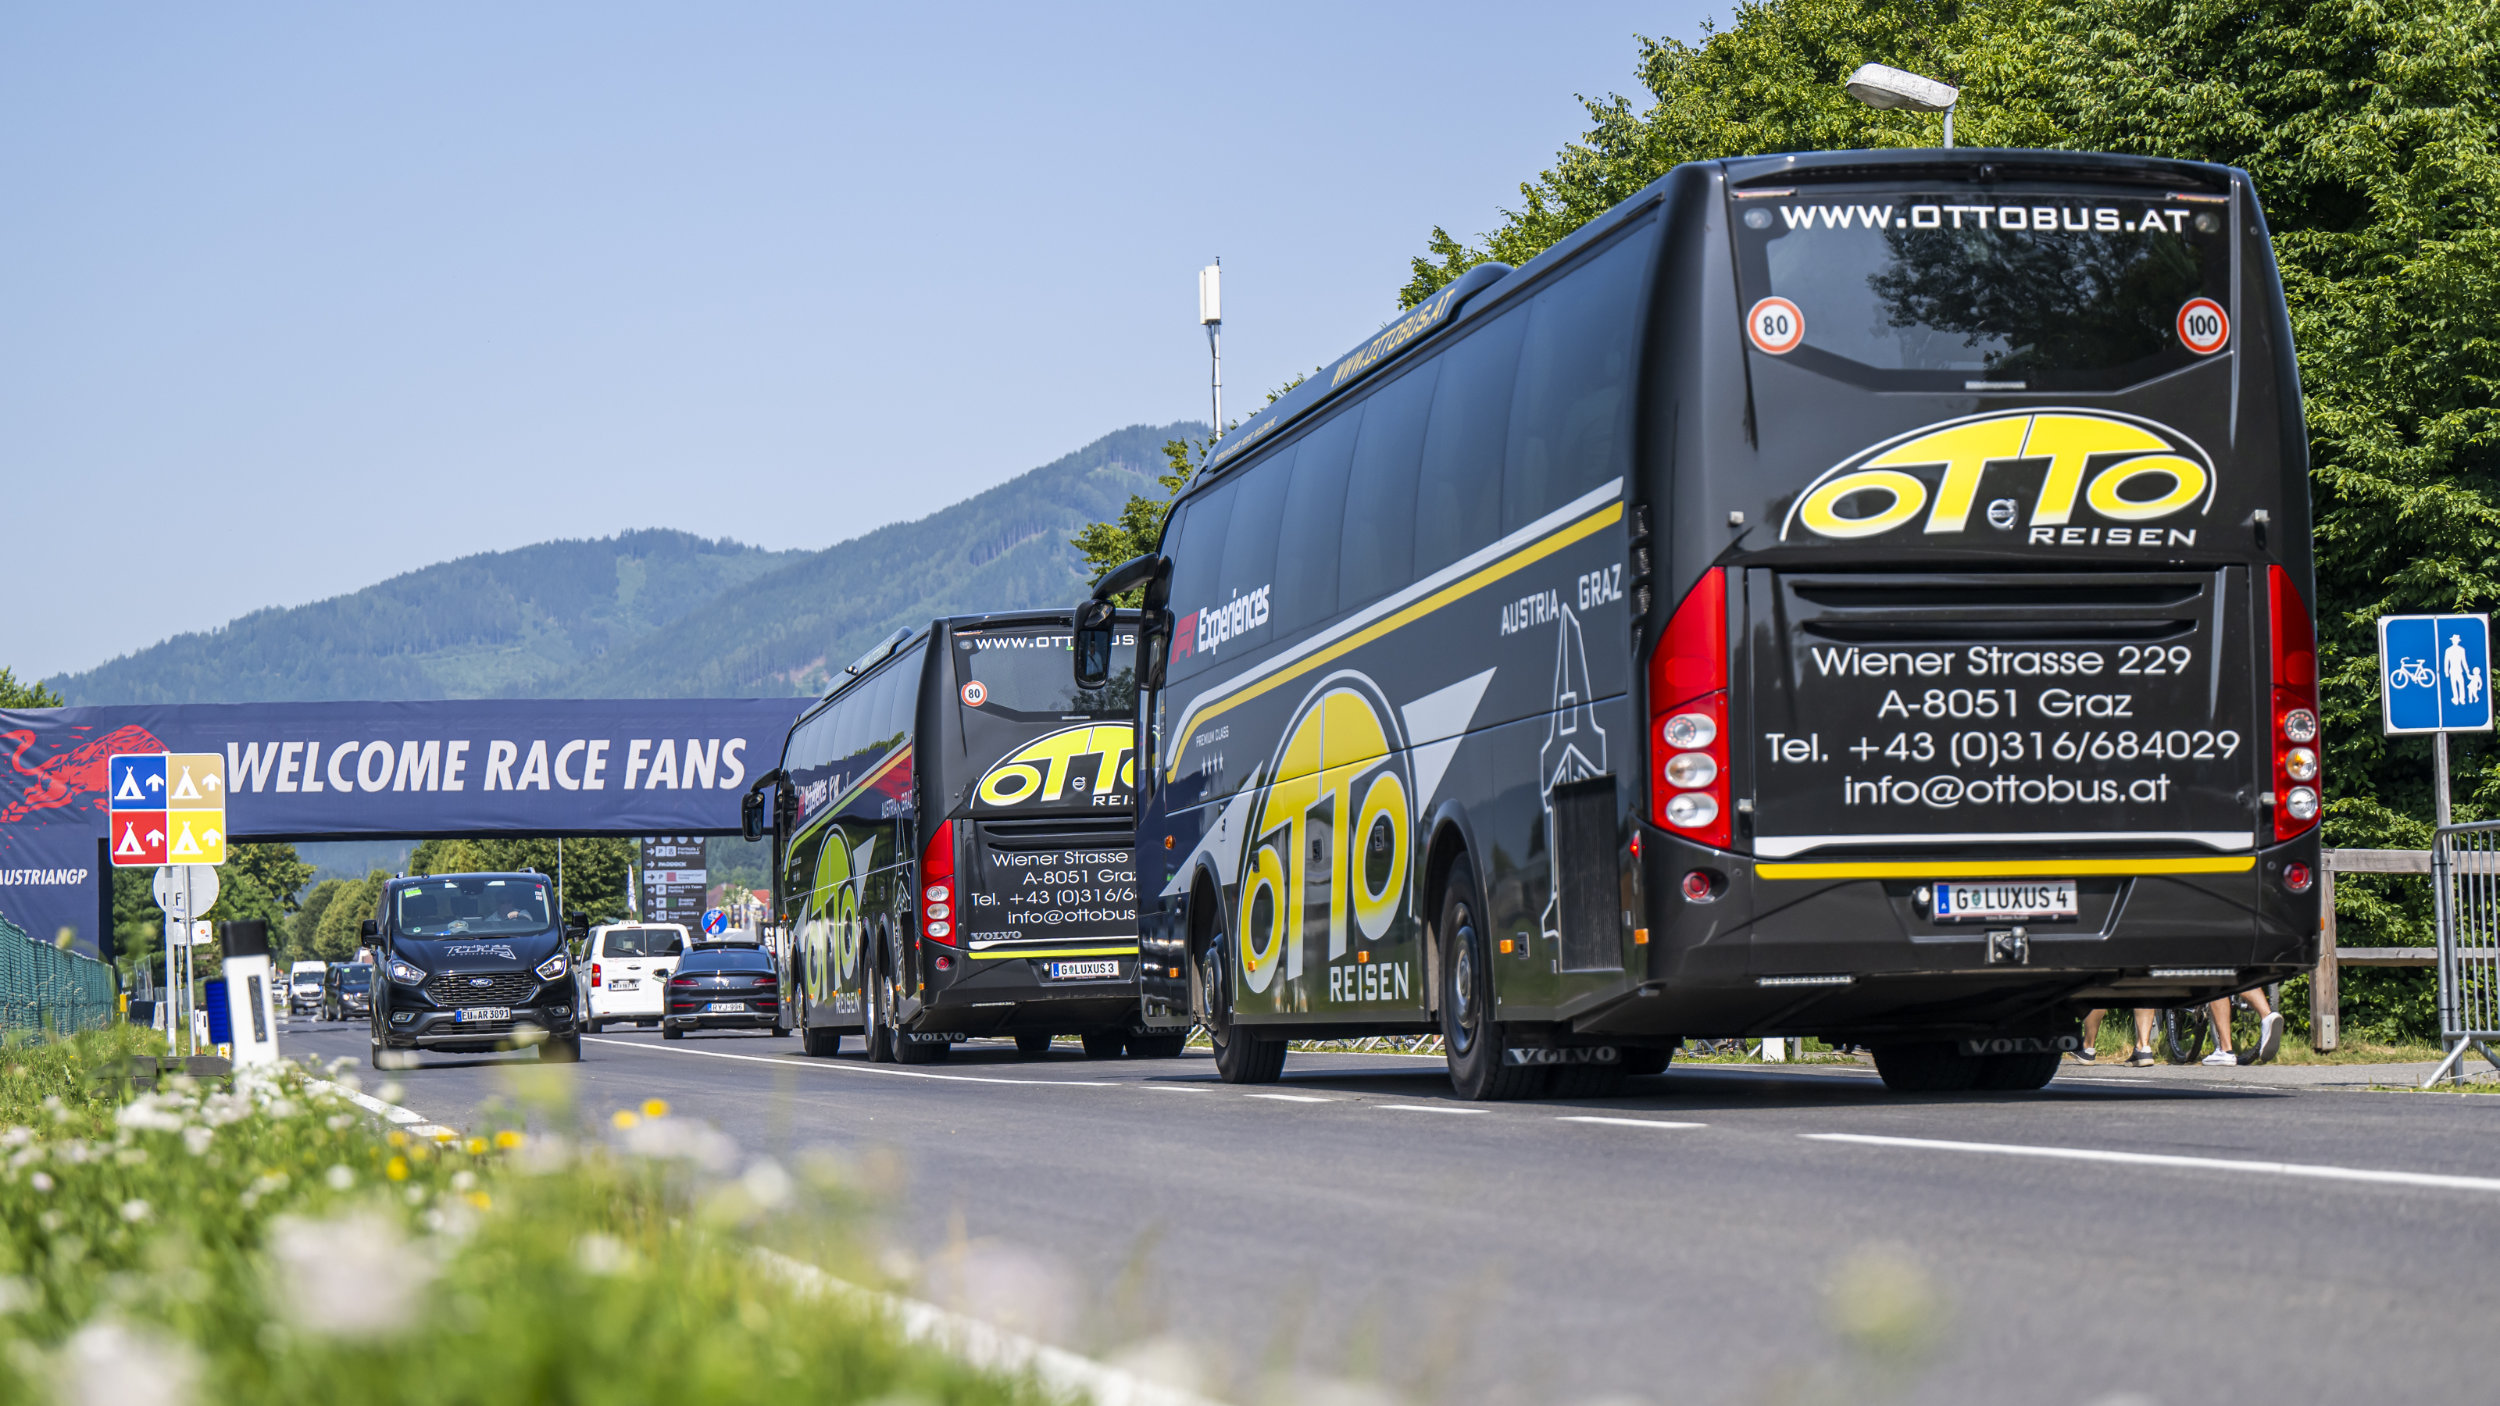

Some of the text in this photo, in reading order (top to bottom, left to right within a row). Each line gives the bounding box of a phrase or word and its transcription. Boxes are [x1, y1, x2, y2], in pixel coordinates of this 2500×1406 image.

[1779, 204, 2190, 233] WWW.OTTOBUS.AT
[1763, 315, 1788, 335] 80
[2188, 315, 2218, 336] 100
[1331, 288, 1456, 388] WWW.OTTOBUS.AT
[2028, 527, 2196, 546] REISEN
[1501, 563, 1623, 636] AUSTRIA GRAZ
[1198, 584, 1270, 655] Experiences
[975, 634, 1135, 650] WWW.OTTUS
[1812, 645, 2192, 676] Wiener Strasse 229
[968, 688, 981, 699] 80
[1878, 688, 2133, 719] A-8051 Graz
[1765, 730, 2241, 767] Tel. +43 (0)316/684029
[226, 738, 747, 793] WELCOME RACE FANS
[980, 725, 1134, 807] OTT
[1093, 795, 1134, 806] REI
[1845, 773, 2171, 808] info@ottobus.at
[992, 851, 1129, 867] Wiener Strasse
[1023, 869, 1137, 886] A-8051 Gra
[971, 887, 1137, 906] Tel. +43 (0)316/6
[1956, 888, 1968, 909] G
[1985, 886, 2051, 909] LUXUS
[2056, 886, 2068, 908] 4
[1007, 908, 1136, 925] info@ottobus
[970, 930, 1023, 940] VOLVO
[1061, 964, 1068, 975] G
[1074, 963, 1105, 974] LUXUS
[1108, 963, 1115, 973] 3
[1329, 961, 1410, 1003] REISEN
[908, 1032, 966, 1042] VOLVO
[1969, 1035, 2079, 1053] VOLVO
[1508, 1046, 1617, 1064] VOLVO
